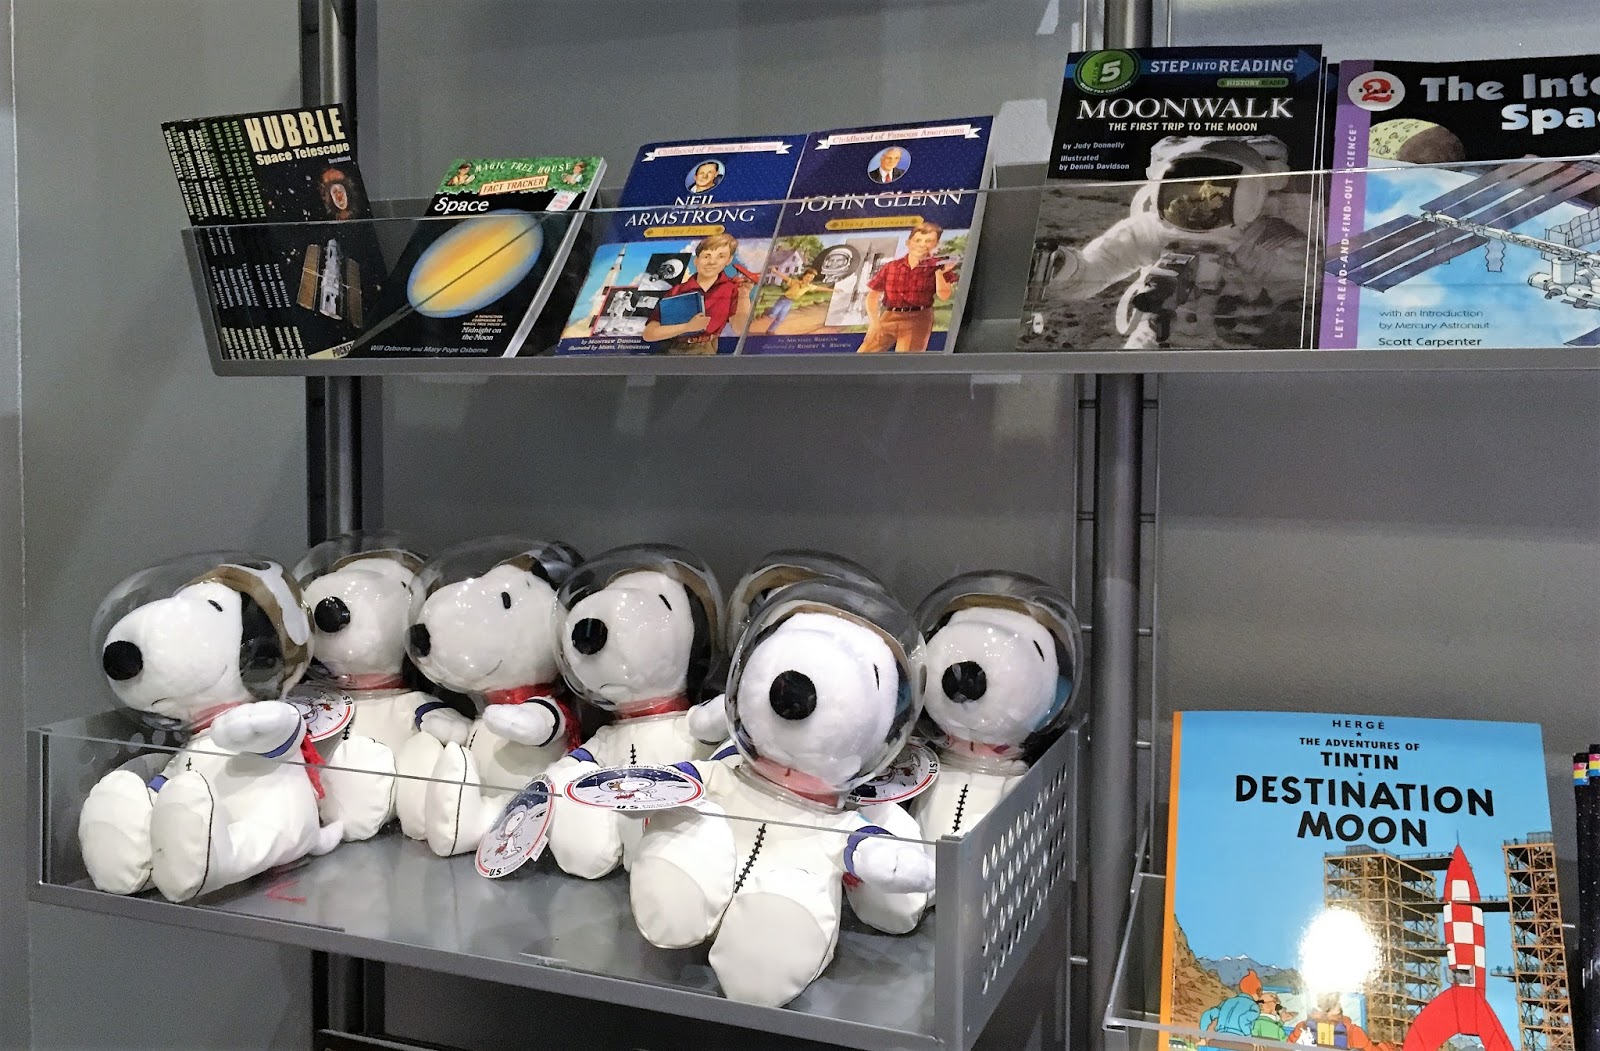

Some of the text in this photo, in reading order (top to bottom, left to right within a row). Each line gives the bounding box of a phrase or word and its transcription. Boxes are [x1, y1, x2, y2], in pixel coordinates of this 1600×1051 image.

[1100, 60, 1121, 82] 5
[1150, 59, 1294, 73] STEP INTO READING
[1362, 78, 1392, 102] 2
[1420, 76, 1504, 102] The
[1077, 98, 1294, 119] MOONWALK
[1108, 123, 1258, 131] THE FIRST TRIP TO THE MOON
[1501, 103, 1600, 135] Spa
[244, 108, 346, 153] HUBBLE
[832, 127, 966, 143] Childhood of Famous Americans
[255, 151, 293, 166] Space
[293, 142, 350, 160] Telescope
[1062, 141, 1125, 150] by Judy Donnelly
[475, 161, 572, 174] MAGIC TREE HOUSE
[1058, 163, 1068, 171] by
[483, 178, 545, 193] FACT TRACKER
[434, 197, 489, 215] Space
[795, 188, 964, 216] JOHN GLENN
[625, 208, 756, 227] ARMSTRONG
[461, 327, 492, 335] Midnight
[1379, 321, 1490, 330] by Mercury Astronaut
[423, 346, 442, 354] Mary
[441, 346, 458, 354] Pope
[1378, 337, 1482, 348] Scott Carpenter
[1332, 719, 1385, 731] HERGÉ
[1299, 737, 1421, 751] THE ADVENTURES OF
[1320, 752, 1399, 770] TINTIN
[1235, 774, 1495, 817] DESTINATION
[1297, 810, 1428, 847] MOON
